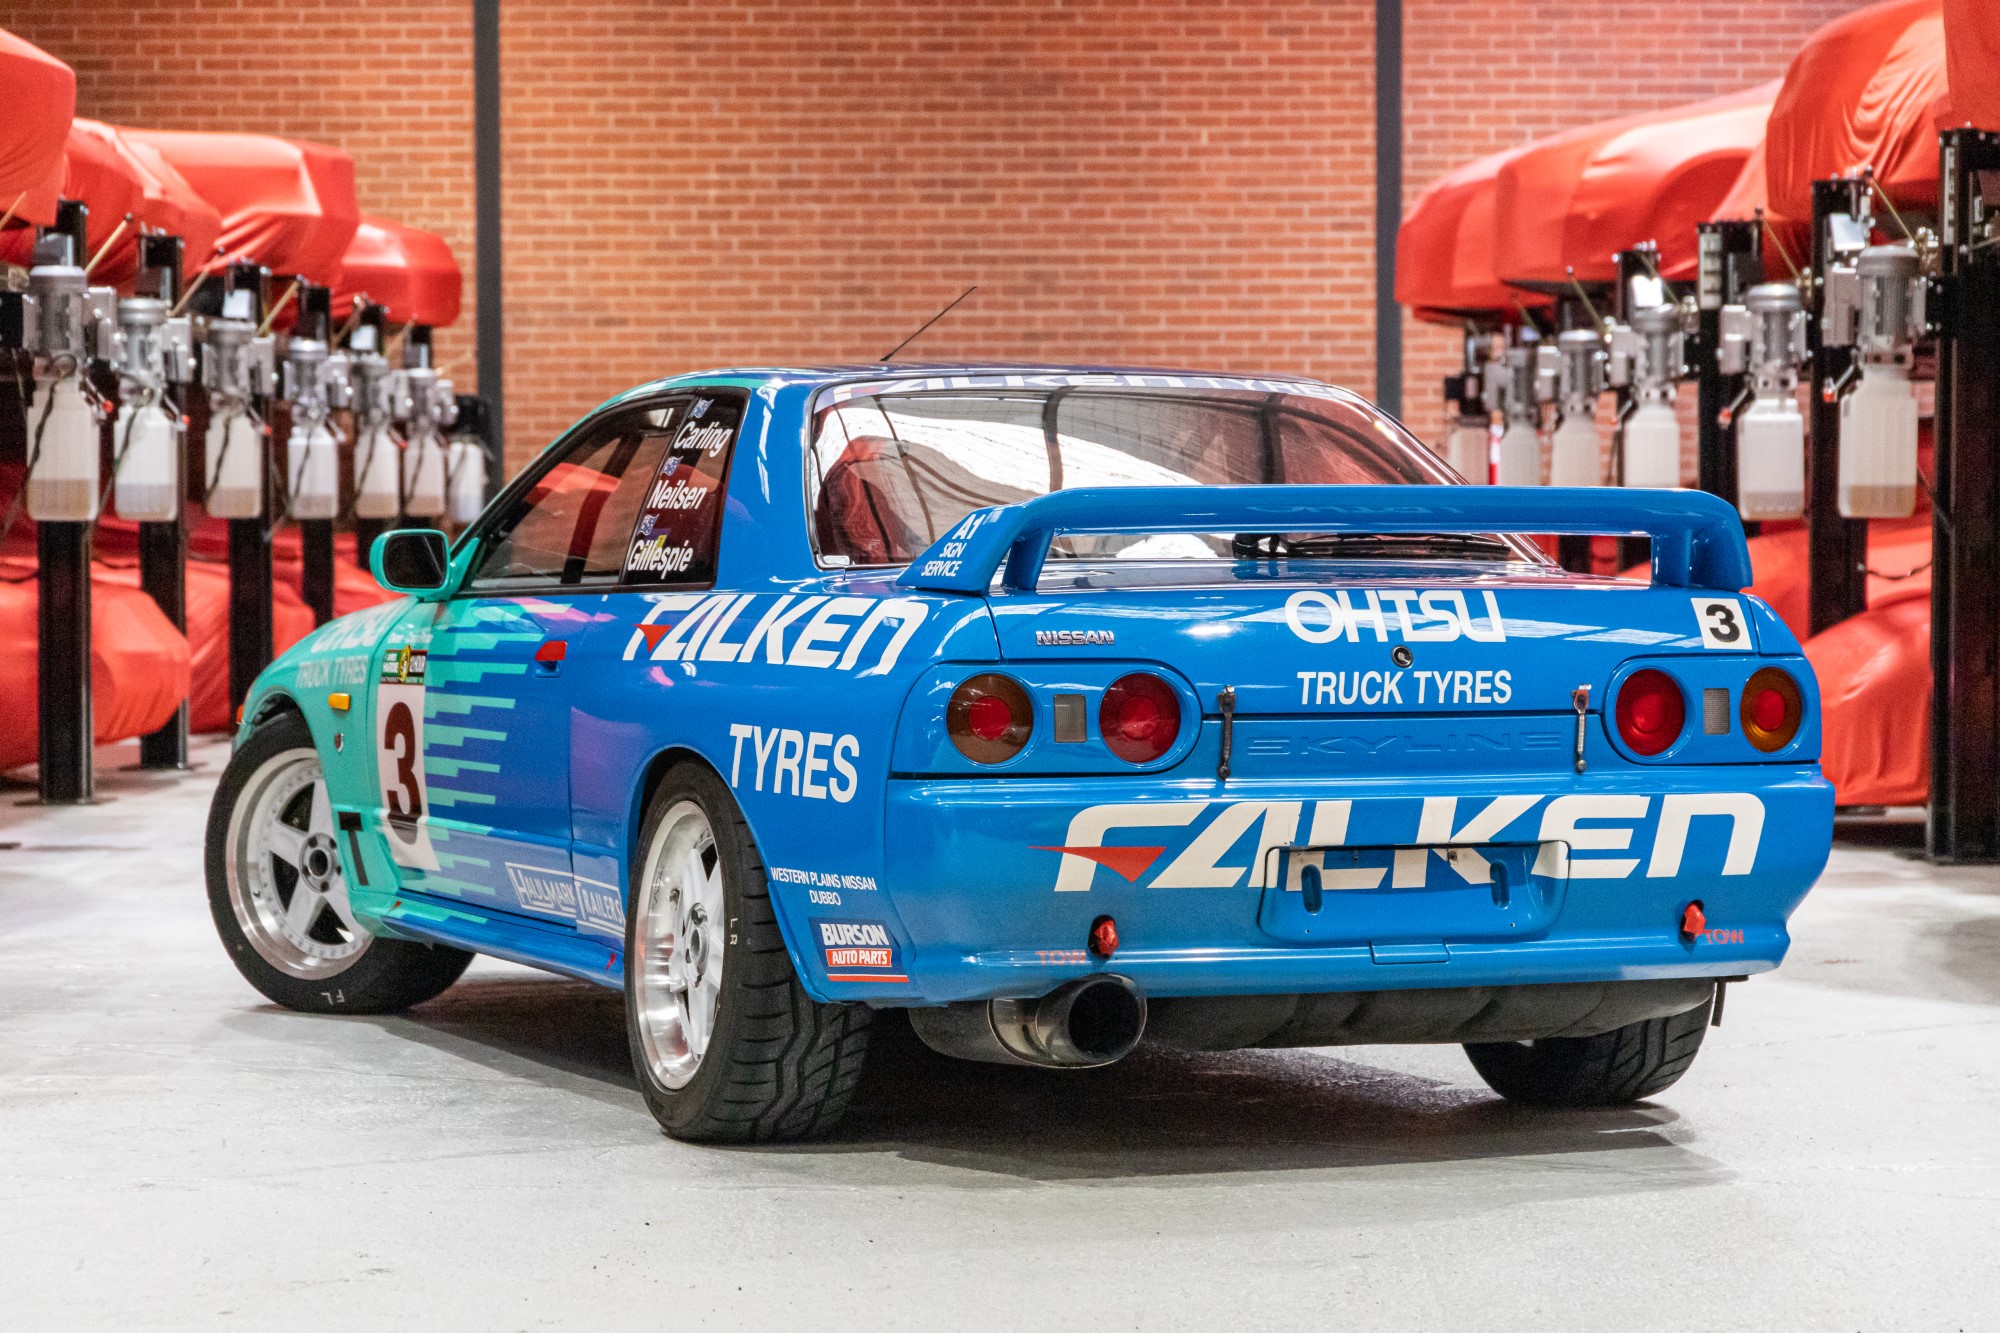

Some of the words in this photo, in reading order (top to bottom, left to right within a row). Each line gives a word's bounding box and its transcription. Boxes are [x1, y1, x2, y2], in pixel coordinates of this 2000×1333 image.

[833, 374, 1188, 402] FALKEN
[673, 421, 734, 457] Carling
[647, 479, 707, 509] Neilsen
[951, 513, 985, 540] A1
[627, 539, 694, 580] Gillespie
[939, 543, 966, 558] SIGN
[921, 560, 962, 577] SERVICE
[1284, 590, 1507, 643] OHTSU
[1705, 604, 1741, 643] 3
[622, 594, 929, 676] FALKEN
[1035, 630, 1115, 645] NISSAN
[1297, 672, 1404, 705] TRUCK
[1413, 670, 1513, 705] TYRES
[1247, 731, 1563, 756] SKYLINE
[384, 702, 423, 845] 3
[729, 723, 860, 804] TYRES
[1028, 793, 1765, 892] FALKEN
[770, 867, 810, 885] WESTERN
[809, 872, 841, 888] PLAINS
[841, 876, 877, 891] NISSAN
[508, 868, 576, 906] HAULMARK
[574, 880, 626, 925] TRAILERS
[809, 890, 841, 906] DUBBO
[820, 923, 890, 946] BURSON
[1705, 929, 1744, 944] TOW
[832, 950, 857, 964] AUTO
[858, 950, 888, 965] PARTS
[1036, 950, 1087, 966] TOW
